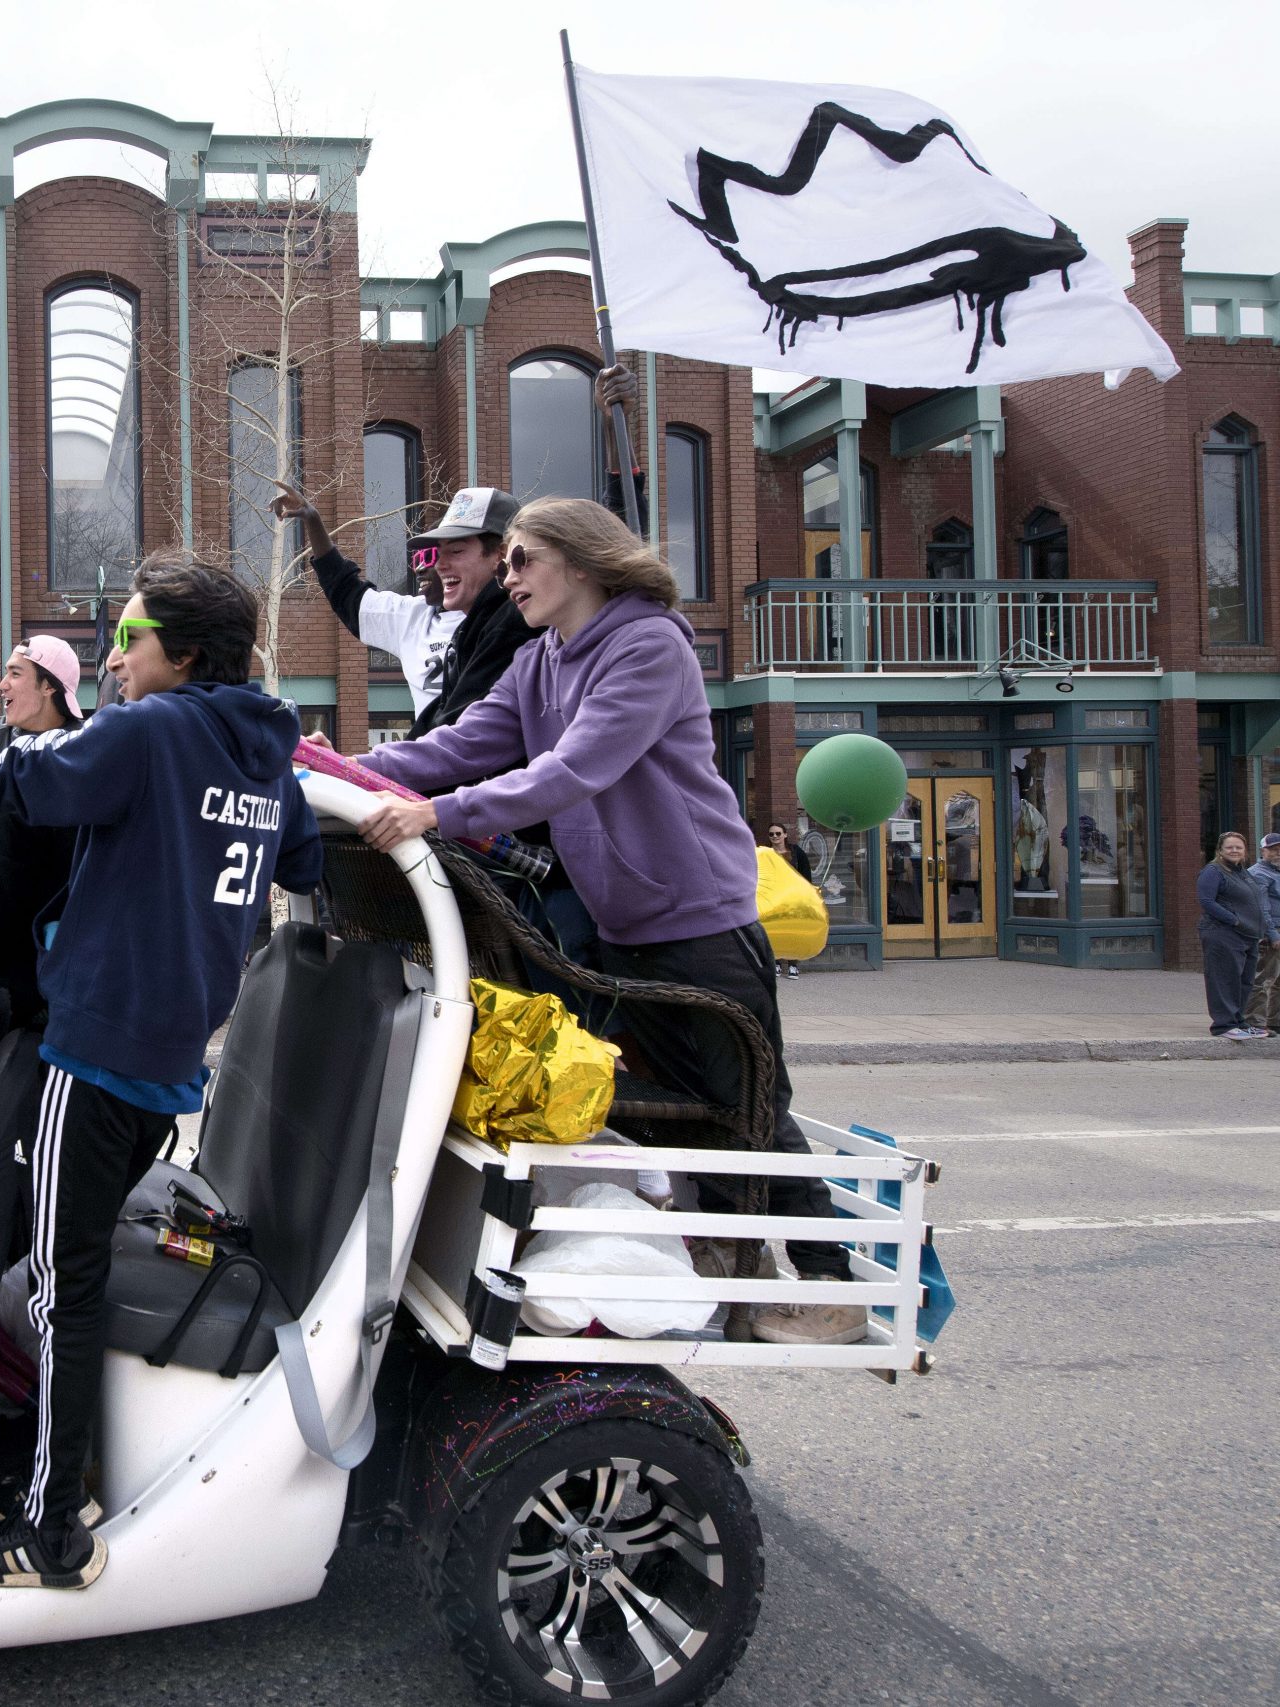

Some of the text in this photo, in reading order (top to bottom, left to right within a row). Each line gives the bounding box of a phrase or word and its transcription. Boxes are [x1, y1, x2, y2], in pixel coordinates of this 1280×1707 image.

[200, 786, 281, 831] CASTILLO
[213, 841, 264, 905] 21
[588, 1556, 611, 1571] SS
